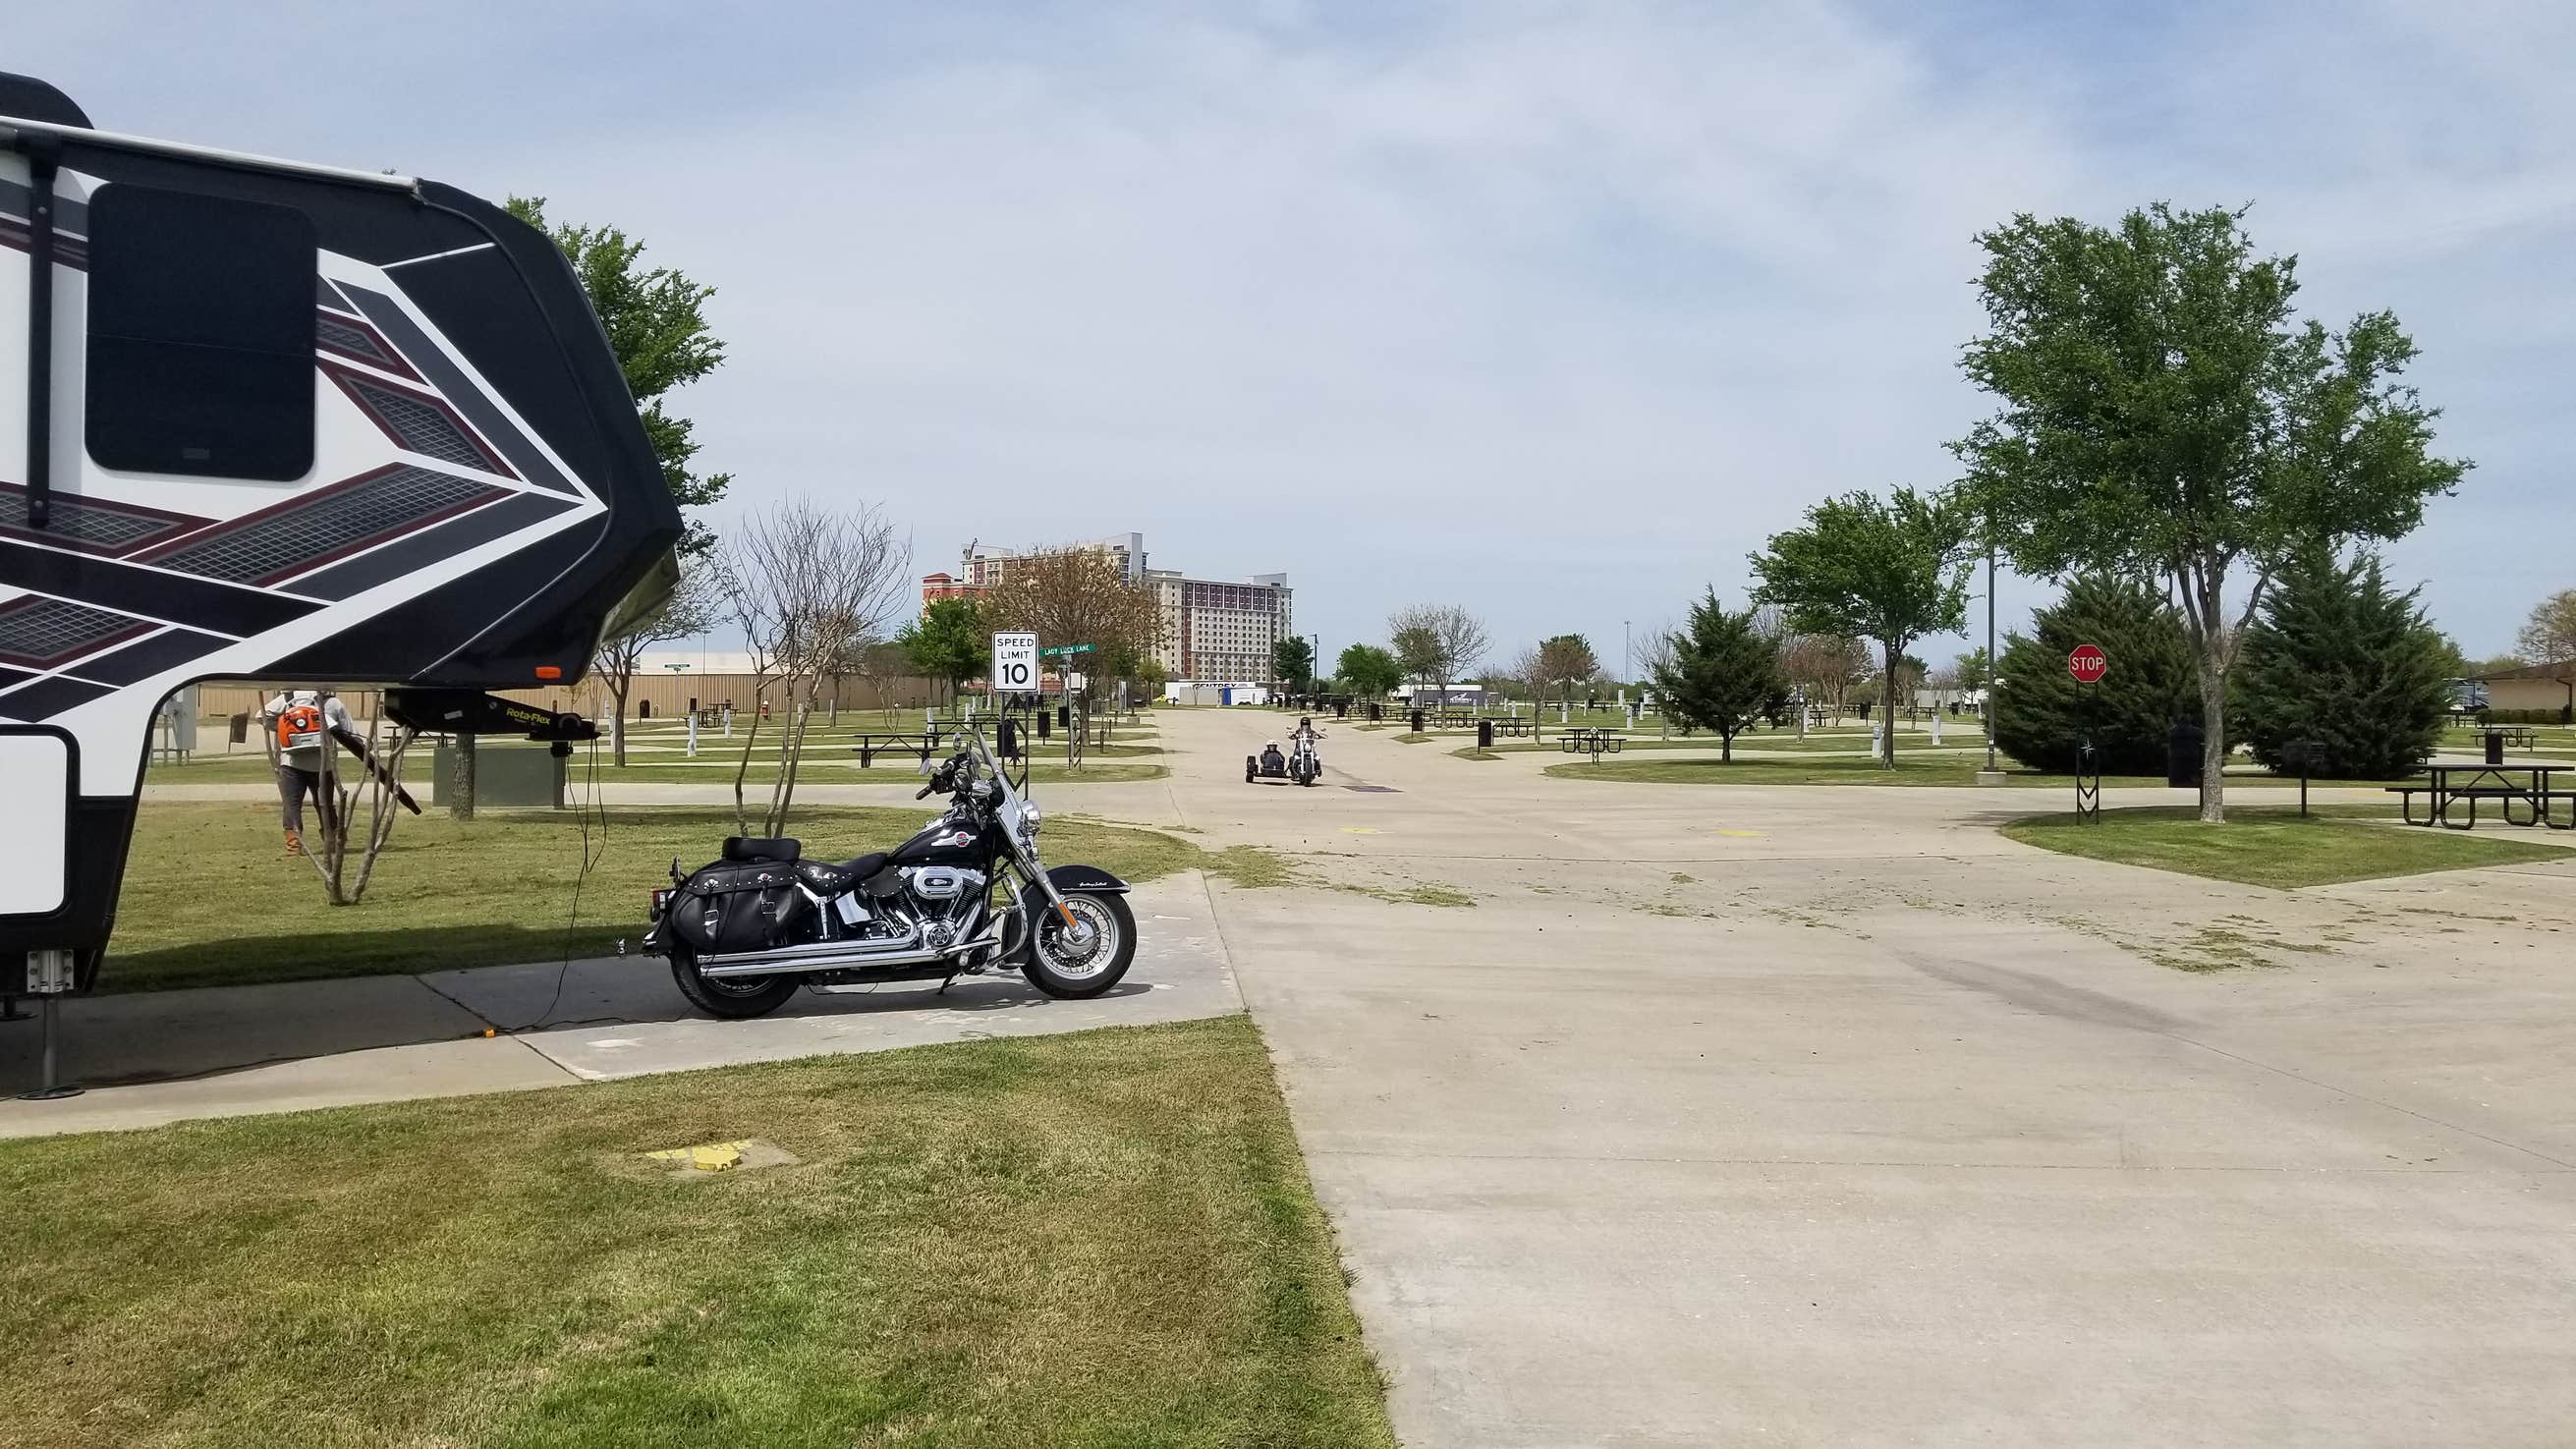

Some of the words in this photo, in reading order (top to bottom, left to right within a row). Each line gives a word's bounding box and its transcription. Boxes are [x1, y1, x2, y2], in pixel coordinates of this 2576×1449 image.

[1076, 643, 1091, 652] LANE
[2072, 657, 2103, 671] STOP
[1002, 663, 1029, 685] 10
[506, 707, 550, 725] Rota-Flex
